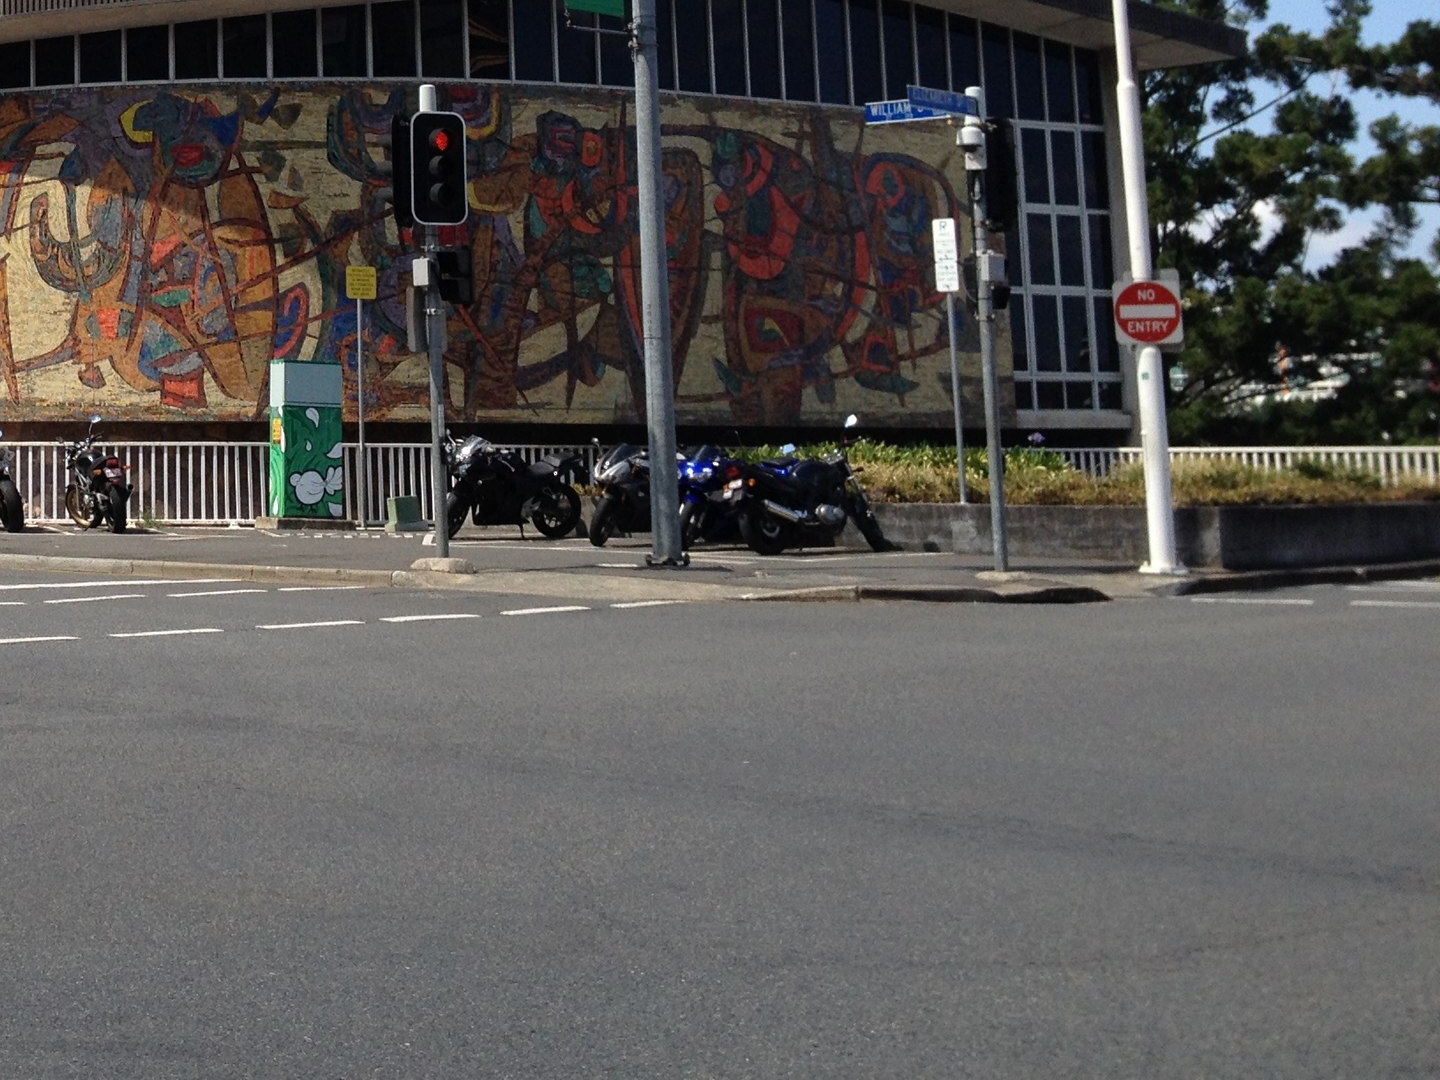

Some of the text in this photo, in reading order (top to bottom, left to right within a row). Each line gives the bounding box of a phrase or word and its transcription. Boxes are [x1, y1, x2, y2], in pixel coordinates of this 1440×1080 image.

[870, 101, 912, 117] WILLIAM
[1137, 289, 1155, 301] NO
[1127, 321, 1169, 332] ENTRY
